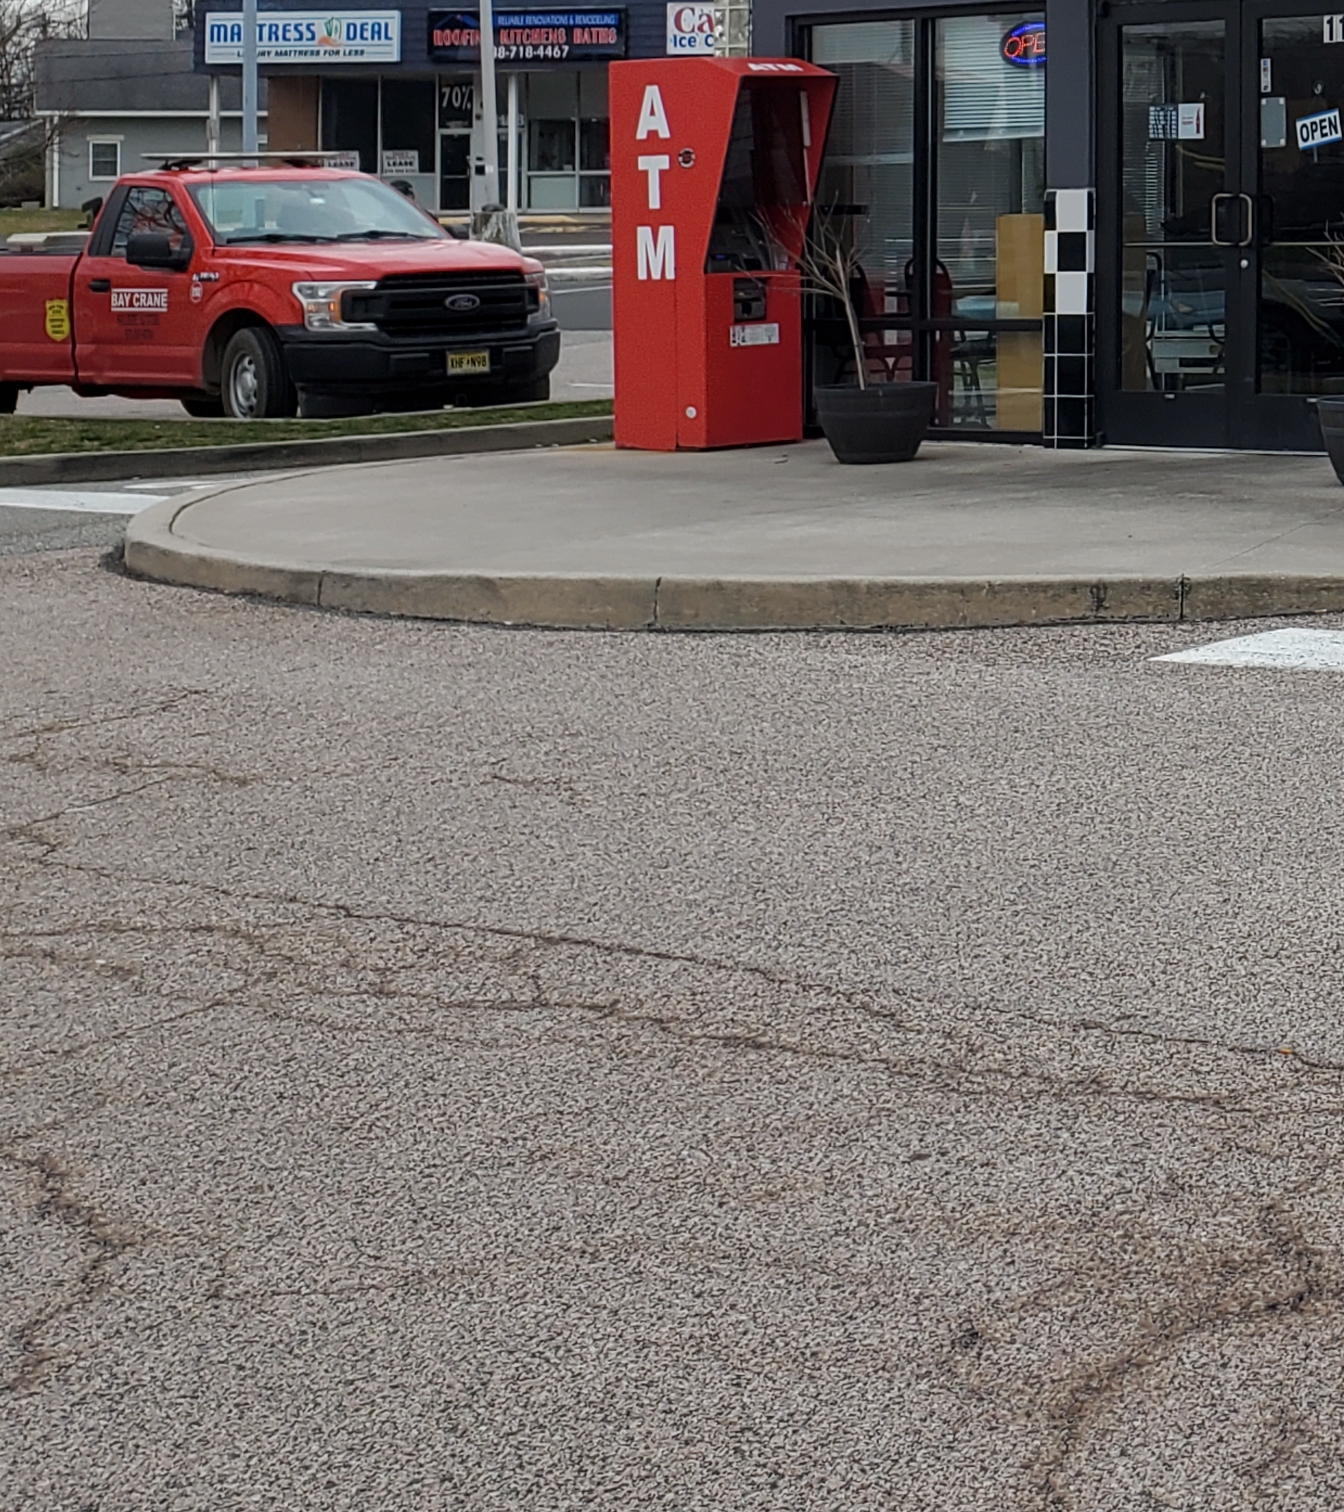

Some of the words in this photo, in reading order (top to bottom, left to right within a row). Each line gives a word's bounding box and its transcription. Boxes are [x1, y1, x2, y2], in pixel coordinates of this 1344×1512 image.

[673, 6, 714, 34] Ca
[209, 22, 316, 43] MATRESS
[345, 21, 394, 42] DEAL
[433, 28, 482, 47] ROOFIN
[499, 27, 567, 45] KITCHENS
[572, 27, 618, 45] BATHS
[672, 34, 697, 48] Ice
[274, 49, 321, 58] MATTRESS
[322, 48, 341, 57] FOR
[342, 48, 366, 57] LESS
[493, 45, 570, 59] 8-718-4467
[1003, 31, 1046, 58] OPE
[746, 62, 805, 72] ATM
[441, 86, 474, 111] 70%
[1299, 114, 1340, 143] OPEN
[636, 84, 676, 281] ATM
[111, 292, 131, 307] BAY
[132, 292, 168, 307] CRANE
